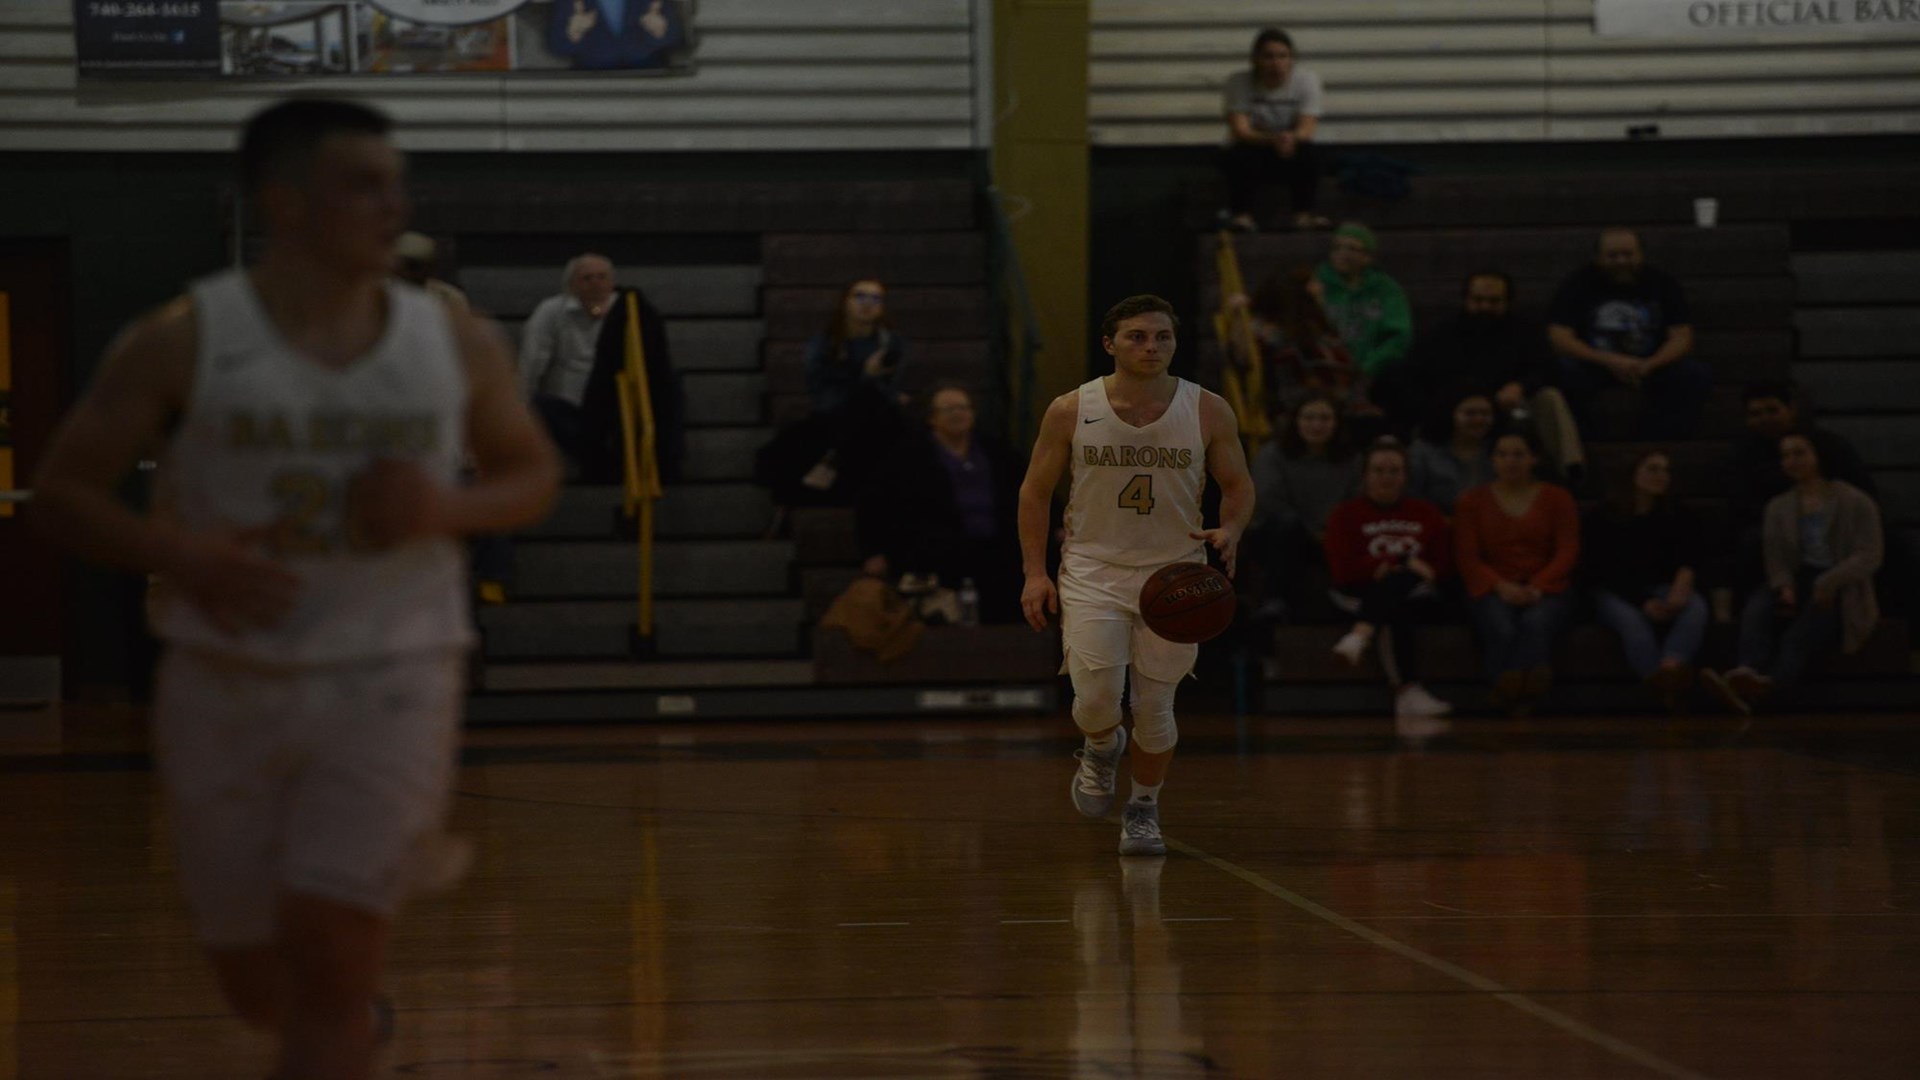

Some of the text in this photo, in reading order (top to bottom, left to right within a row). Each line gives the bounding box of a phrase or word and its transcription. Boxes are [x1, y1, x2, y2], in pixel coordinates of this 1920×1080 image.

[1687, 0, 1841, 27] OFFICIAL
[1083, 445, 1192, 468] BARONS
[1118, 474, 1155, 514] 4
